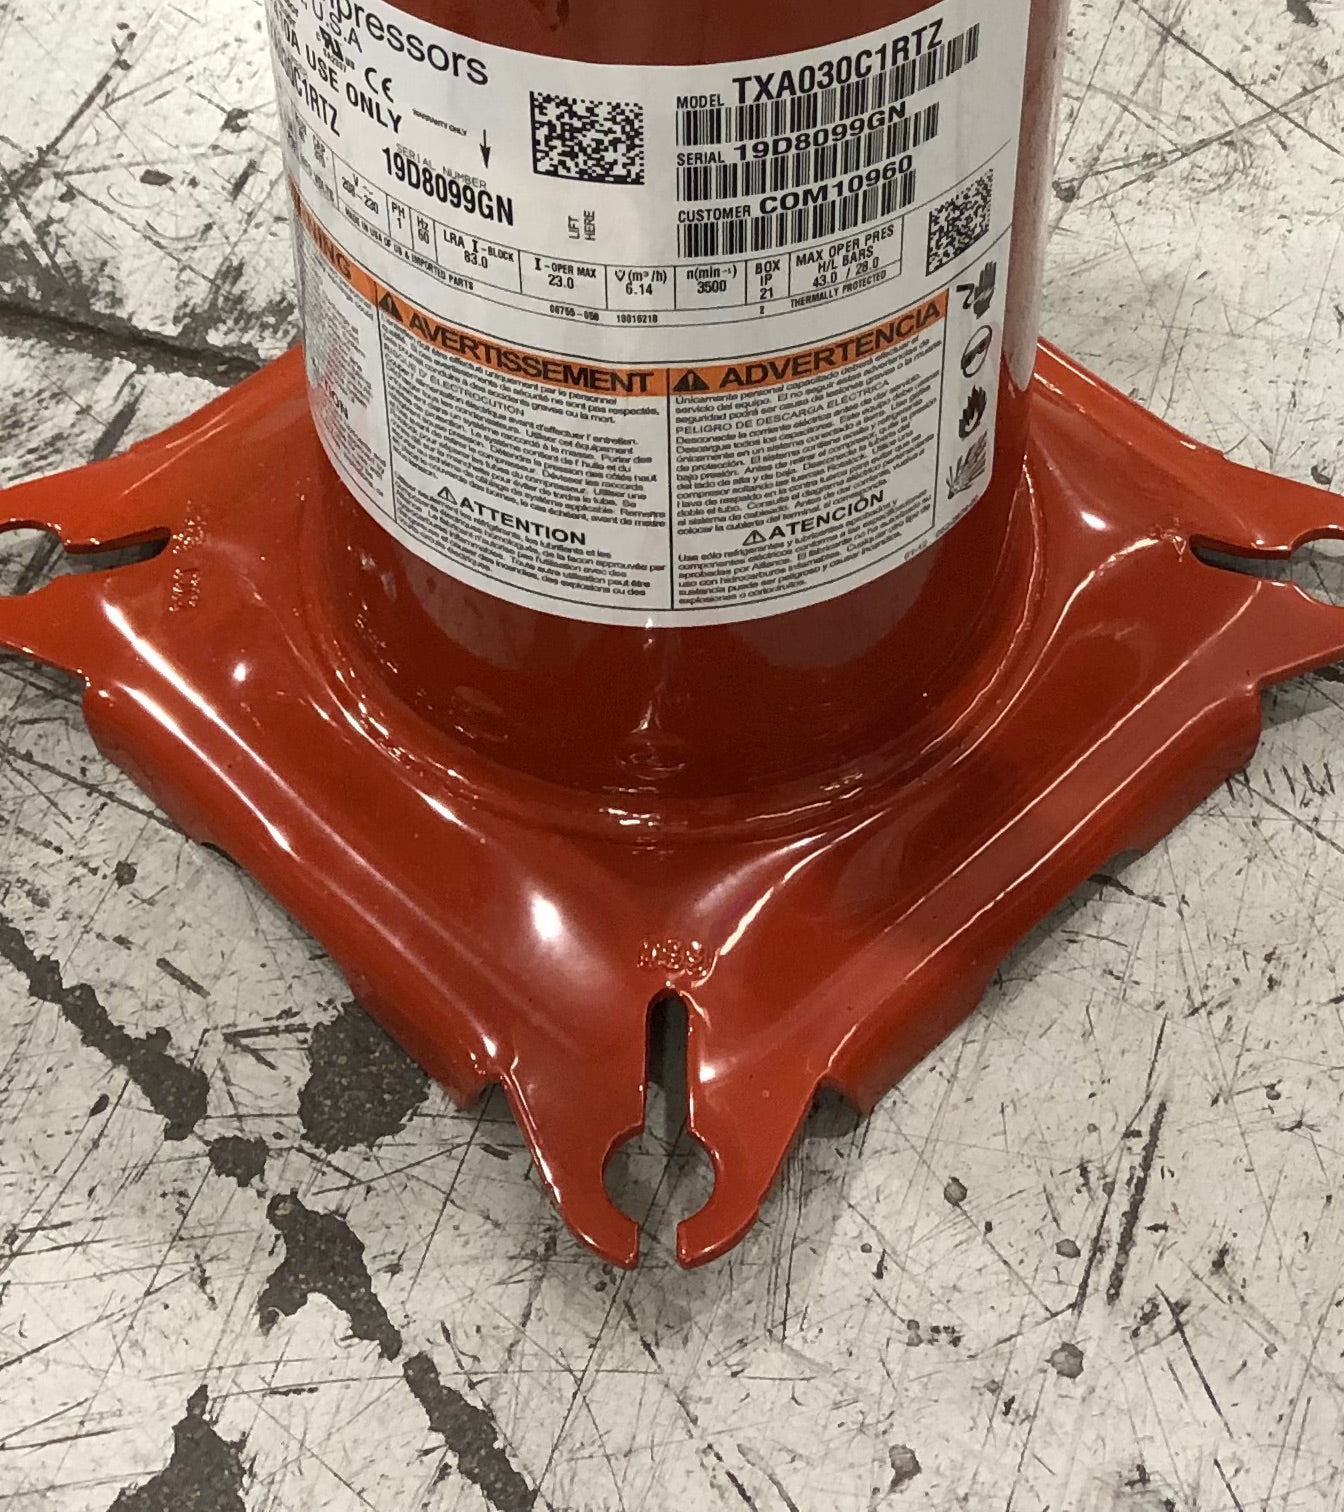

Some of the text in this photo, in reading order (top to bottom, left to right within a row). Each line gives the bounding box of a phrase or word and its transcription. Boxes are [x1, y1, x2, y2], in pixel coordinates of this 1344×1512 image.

[676, 17, 944, 110] MODEL TXA030C1RTZ
[305, 42, 340, 94] USE
[346, 82, 403, 134] ONLY
[676, 100, 907, 167] SERIAL 19D8099GN
[395, 142, 488, 190] SERIAL NUMBER
[381, 146, 514, 227] 19D8099GN
[677, 154, 914, 224] CUSTOMER COM10960
[391, 201, 406, 219] PH
[416, 215, 430, 233] Hz
[583, 209, 597, 242] HERE
[443, 229, 465, 249] LRA
[795, 223, 895, 268] MAX OPER PRES
[464, 250, 488, 269] 83.0
[577, 266, 597, 279] MAX
[754, 259, 781, 276] BOX
[813, 270, 838, 288] 43.0
[855, 256, 880, 277] 28.0
[817, 245, 874, 274] H/L BARS
[447, 272, 474, 291] PARTS
[547, 273, 575, 289] 23.0
[625, 283, 653, 296] 6.14
[696, 279, 727, 295] 3500
[759, 274, 773, 287] IP
[759, 287, 774, 301] 21
[790, 269, 887, 309] THERMALLY PROTECTED
[408, 312, 655, 394] AVERTISSEMENT
[719, 301, 941, 389] ADVERTENCIA
[459, 496, 586, 545] ATTENTION
[768, 489, 886, 540] ATENCIÓN
